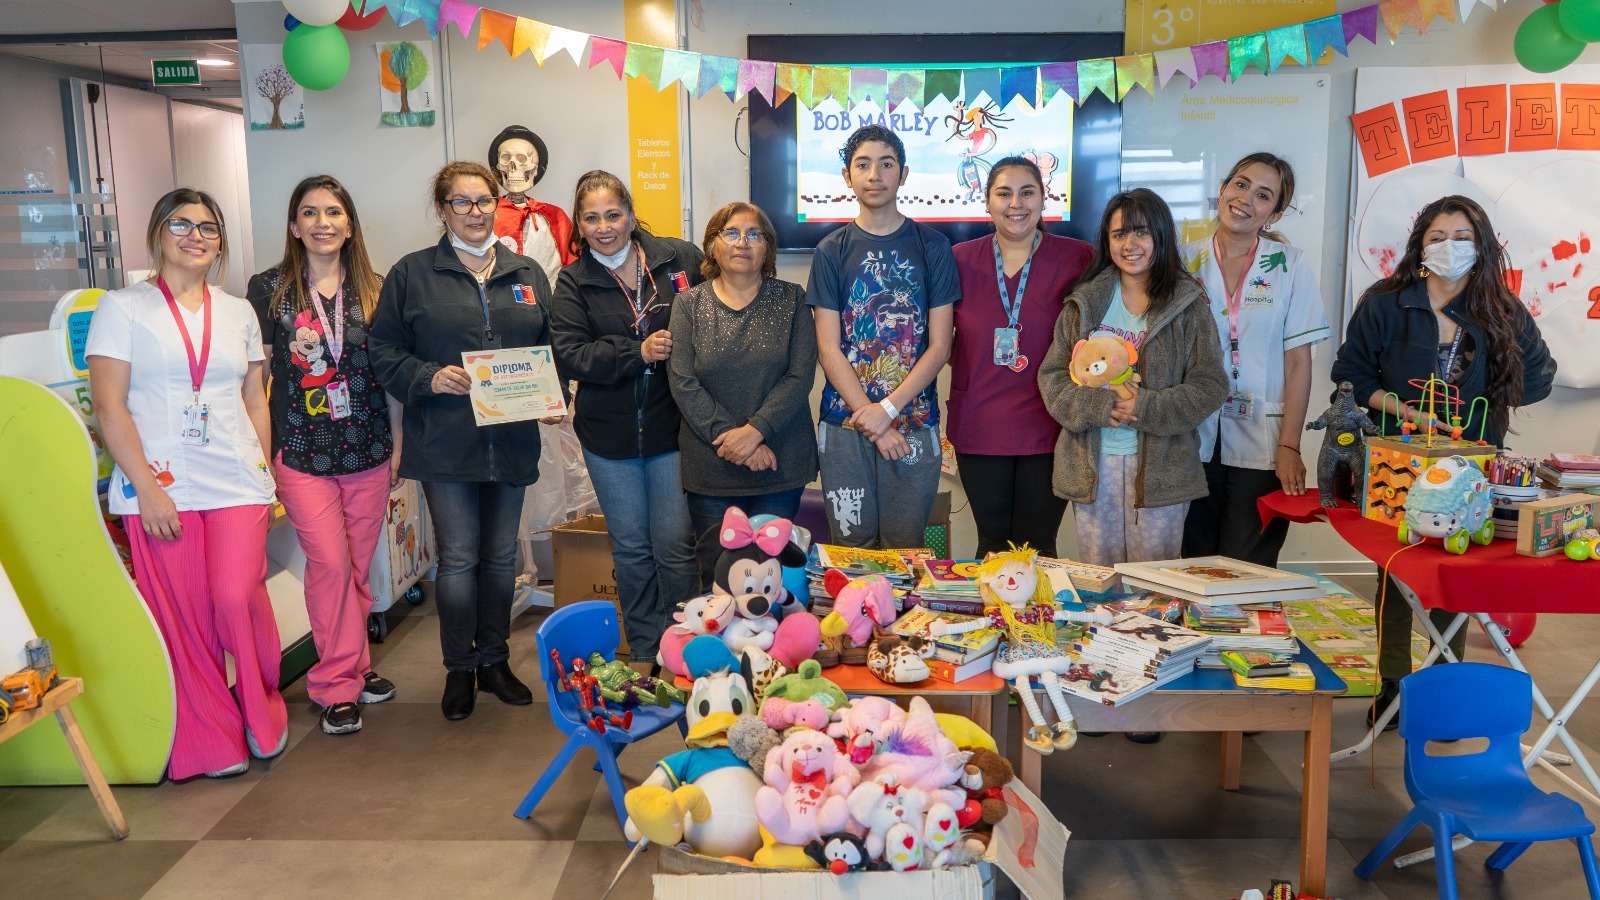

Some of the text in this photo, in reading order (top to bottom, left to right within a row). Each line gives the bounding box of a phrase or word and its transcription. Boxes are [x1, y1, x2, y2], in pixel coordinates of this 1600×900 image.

[156, 66, 196, 78] SALIDA
[1181, 94, 1299, 106] Área Medicoquirúrgica
[1181, 110, 1216, 120] Infantil
[813, 110, 939, 136] BOB MARLEY
[637, 138, 671, 147] Tableros
[651, 161, 657, 170] y
[637, 171, 670, 179] Rack de
[643, 181, 667, 190] Datos
[1244, 296, 1274, 304] Hospital
[492, 362, 533, 374] DIPLOMA
[794, 786, 804, 794] Te
[794, 797, 816, 806] Amo
